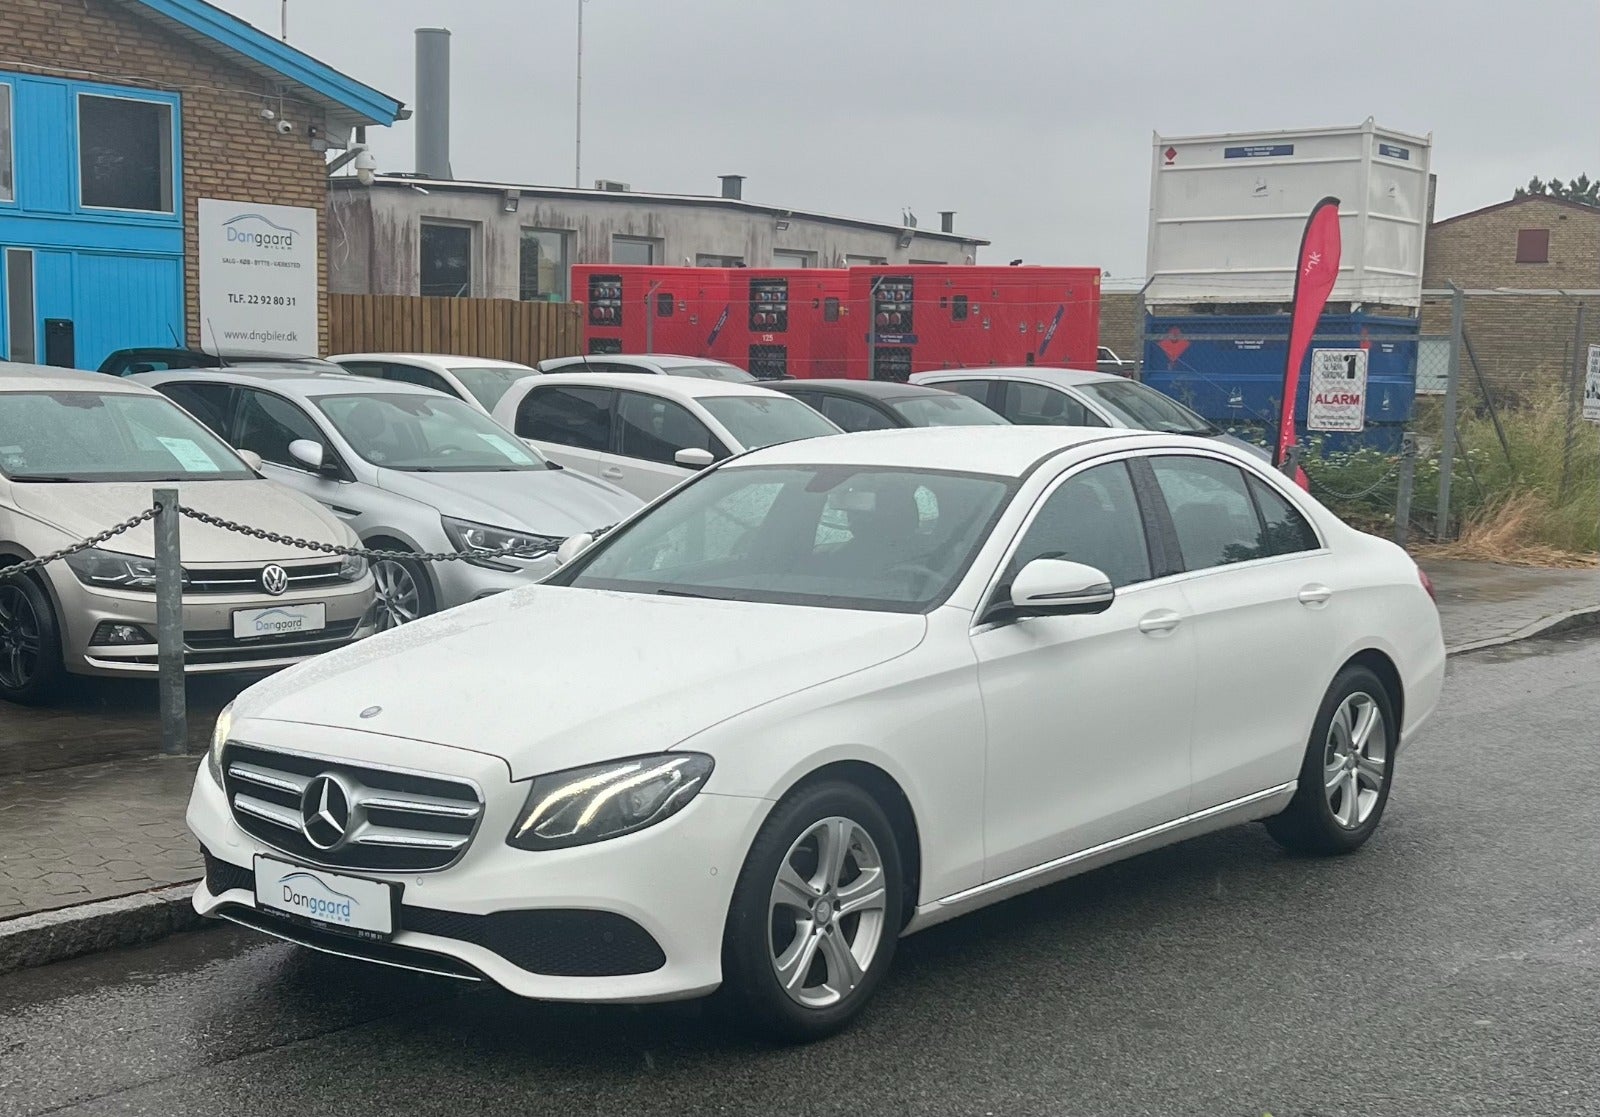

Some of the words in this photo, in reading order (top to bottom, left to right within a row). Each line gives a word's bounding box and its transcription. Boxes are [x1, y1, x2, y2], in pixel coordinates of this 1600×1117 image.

[227, 226, 292, 247] Dangaard
[228, 293, 246, 304] TLF.
[248, 294, 259, 304] 22
[260, 295, 271, 305] 92
[273, 296, 284, 306] 80
[286, 297, 296, 306] 31
[224, 330, 297, 343] www.dngbiler.dk
[1314, 393, 1360, 406] ALARM
[256, 618, 302, 631] Dangaard
[283, 885, 351, 918] Dangaard
